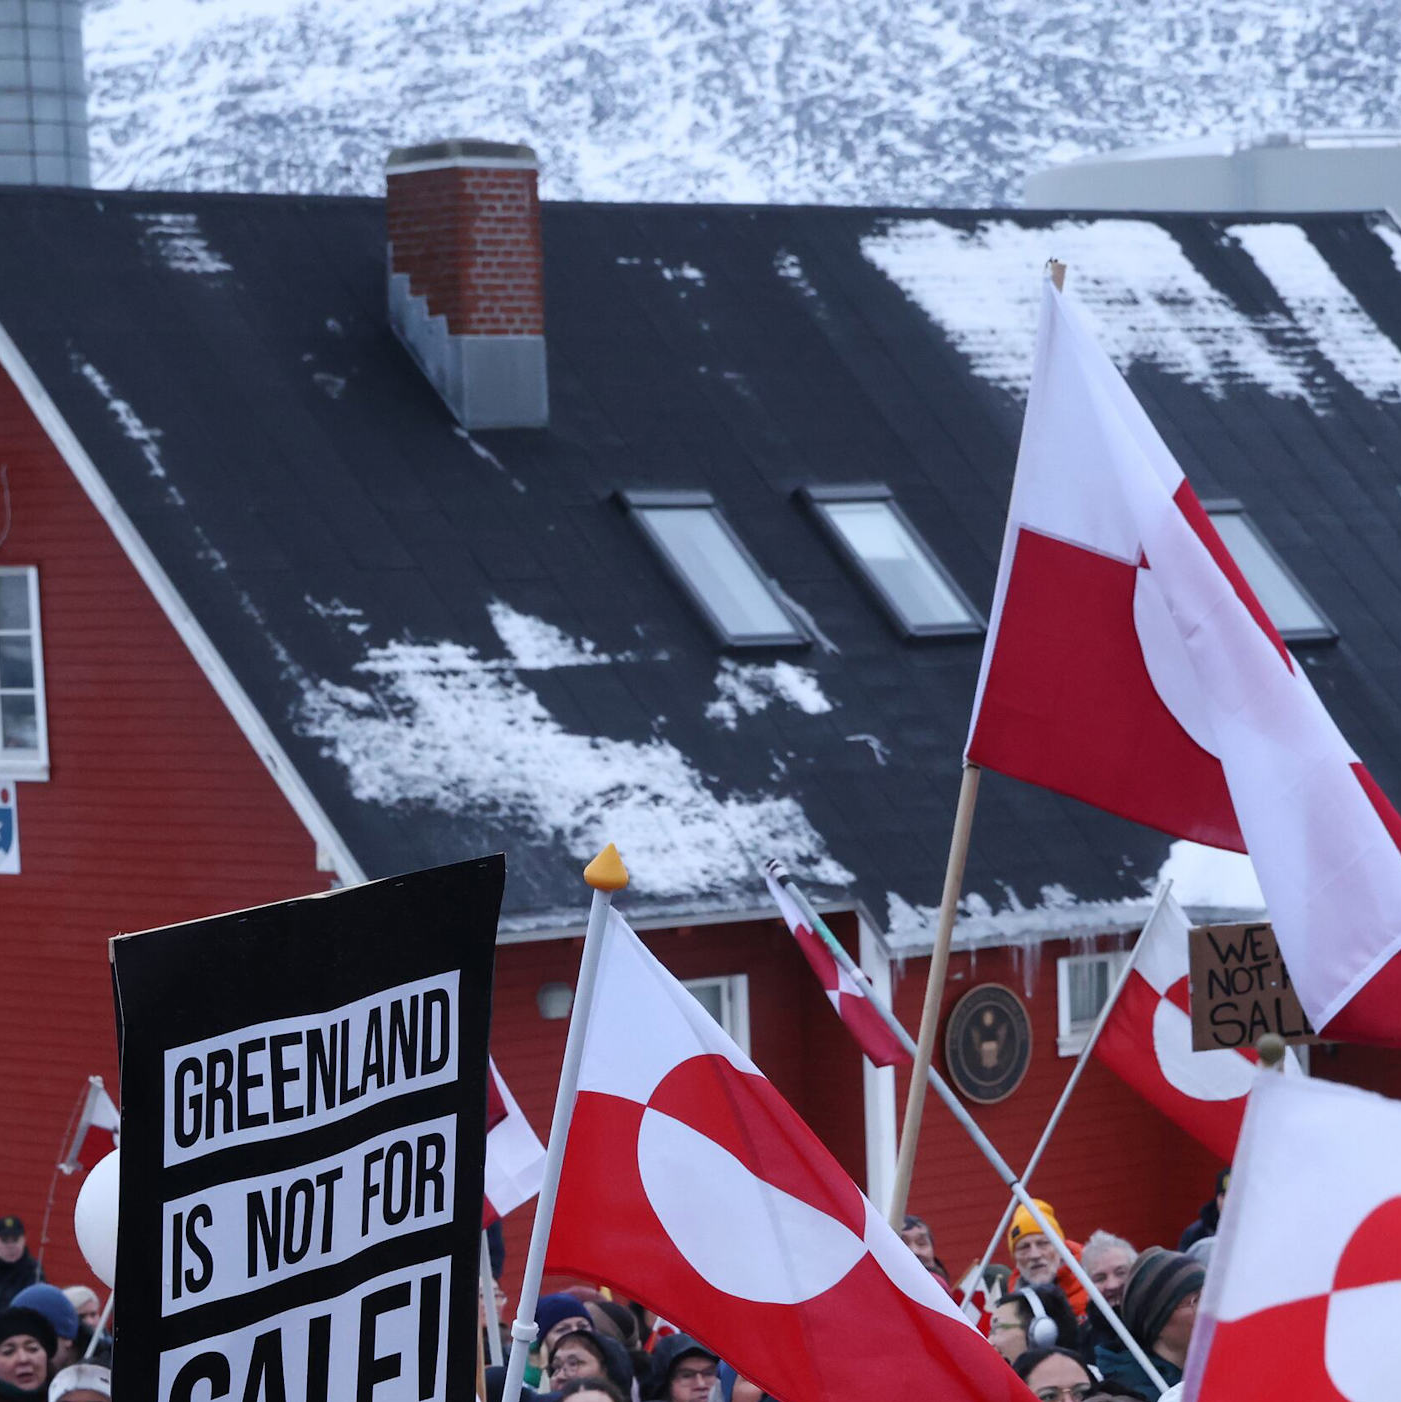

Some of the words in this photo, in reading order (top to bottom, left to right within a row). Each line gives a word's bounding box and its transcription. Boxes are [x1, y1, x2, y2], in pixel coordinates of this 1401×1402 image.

[1206, 925, 1270, 965] WE
[1207, 961, 1272, 1000] NOT
[173, 987, 451, 1149] GREENLAND
[171, 1202, 215, 1301] IS
[247, 1168, 343, 1275] NOT
[362, 1131, 447, 1237] FOR
